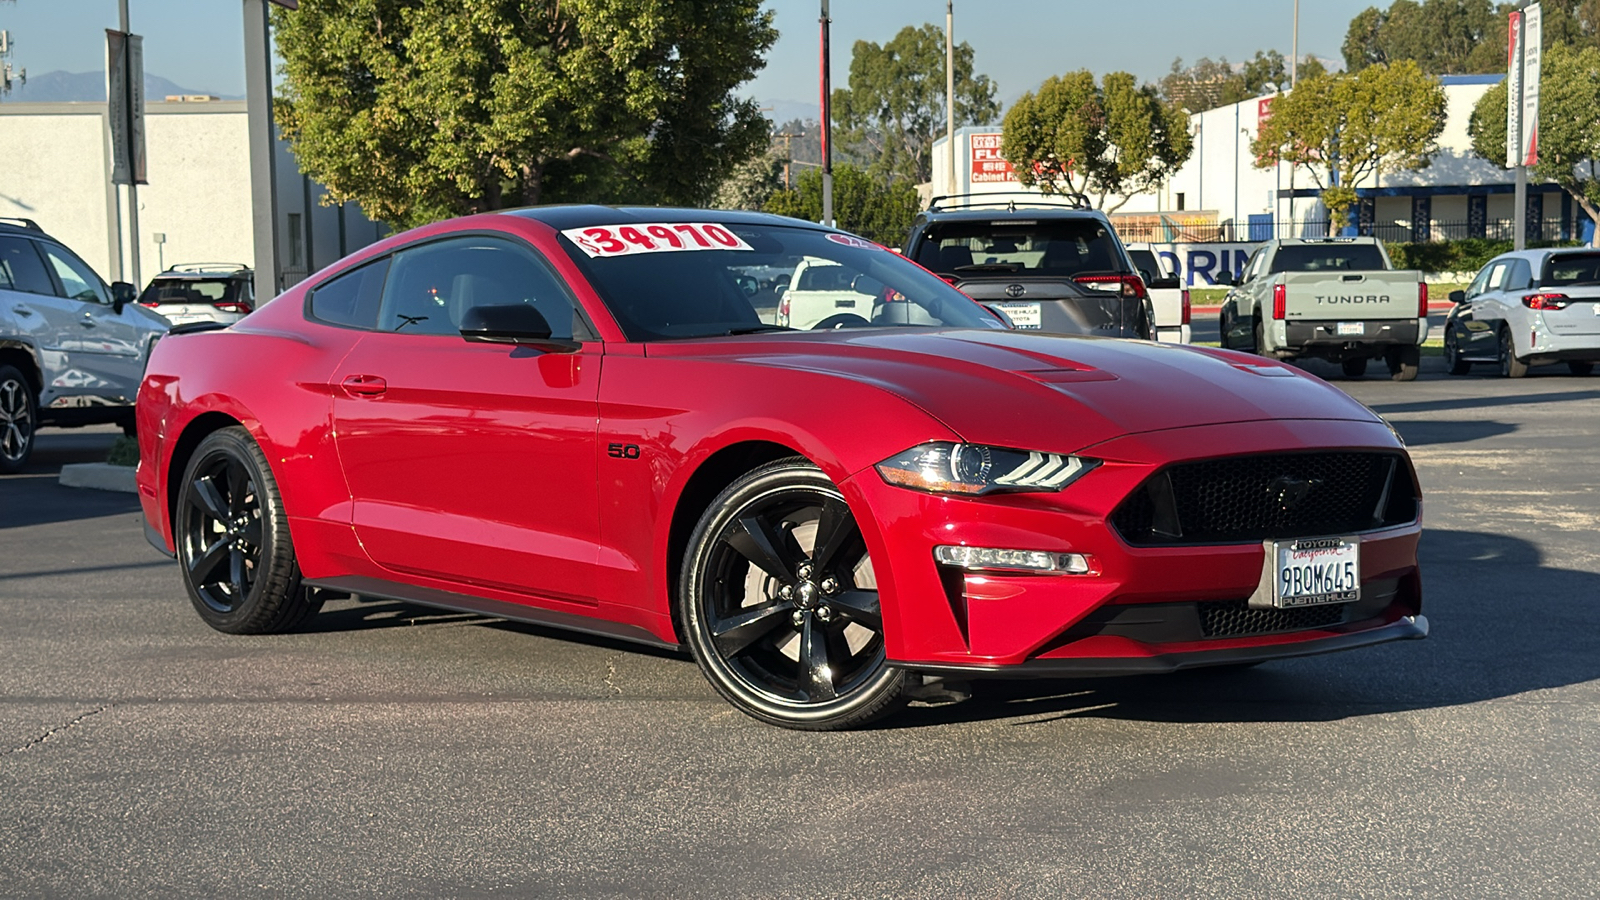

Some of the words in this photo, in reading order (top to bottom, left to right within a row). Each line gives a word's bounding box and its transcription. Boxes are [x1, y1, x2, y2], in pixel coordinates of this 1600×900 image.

[972, 172, 1005, 182] Cabinet
[575, 224, 740, 254] $34970
[1315, 295, 1390, 304] TUNDRA
[1299, 540, 1340, 549] TOYOTA
[1283, 595, 1325, 606] PUENTE
[1326, 591, 1356, 601] HILLS
